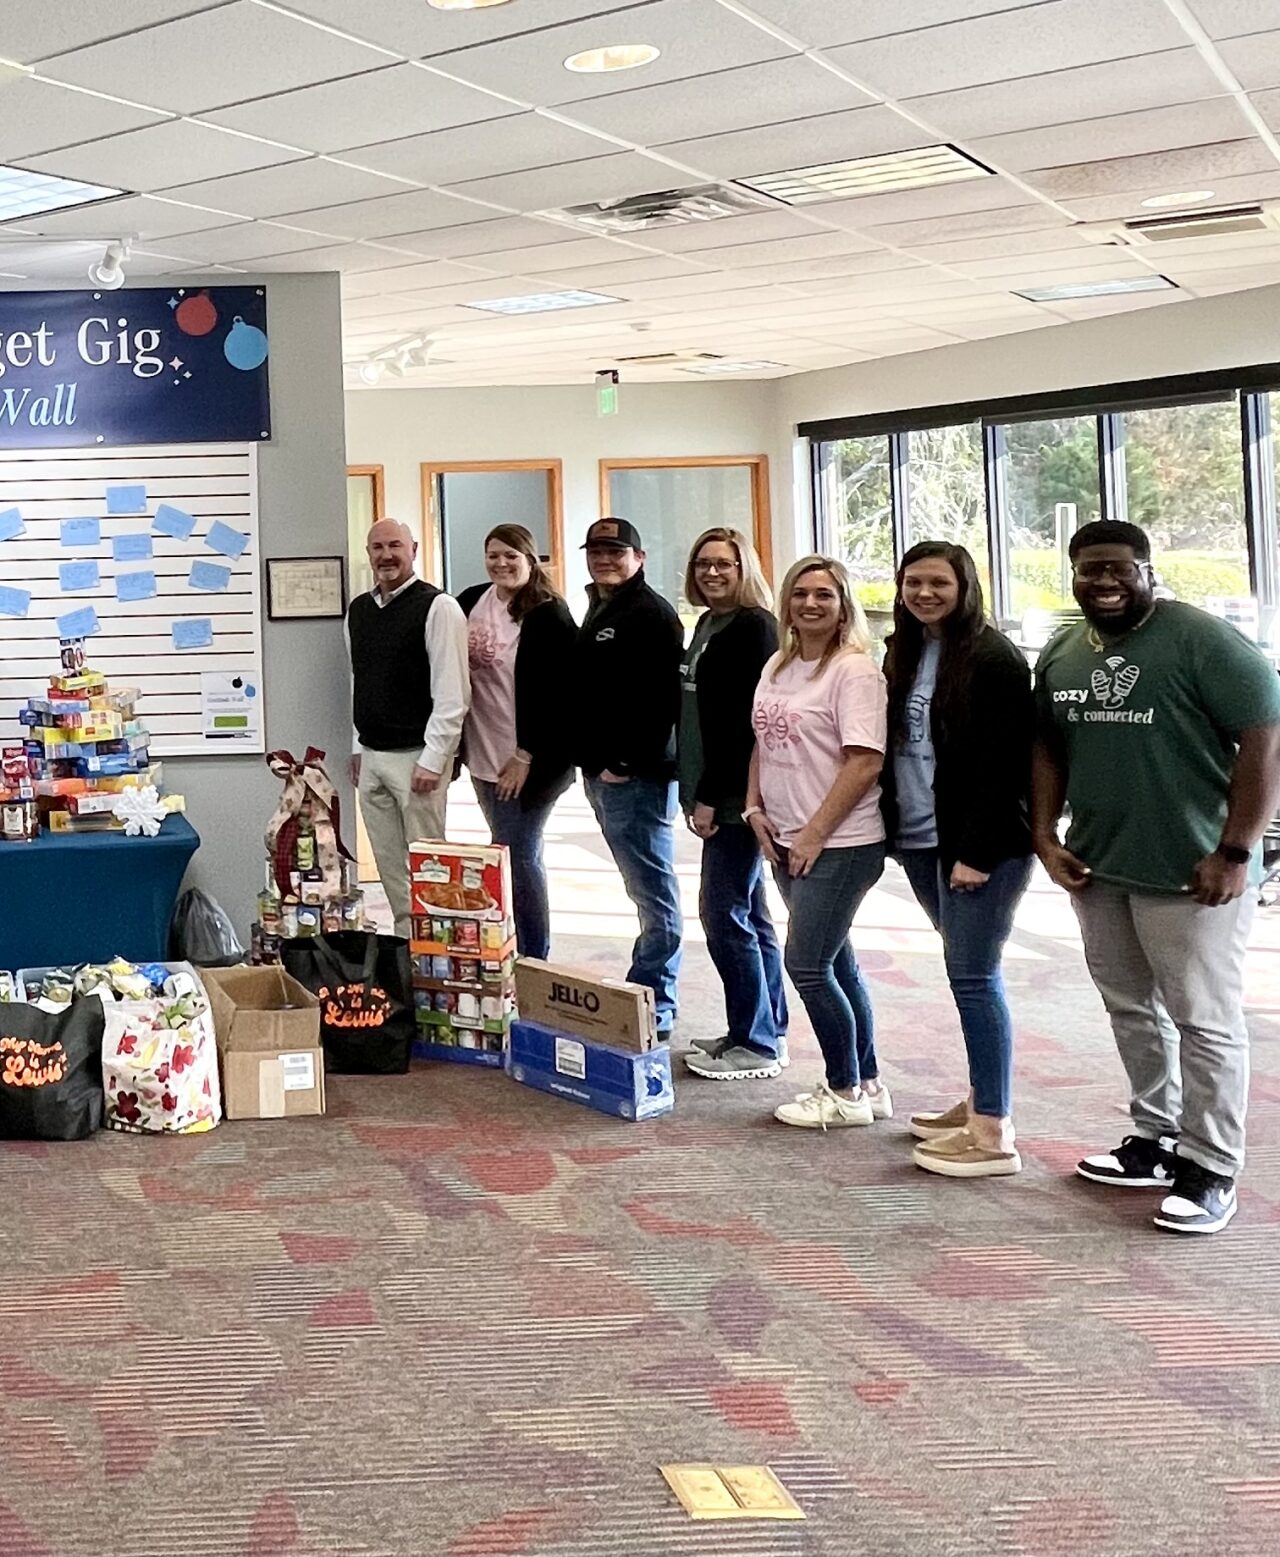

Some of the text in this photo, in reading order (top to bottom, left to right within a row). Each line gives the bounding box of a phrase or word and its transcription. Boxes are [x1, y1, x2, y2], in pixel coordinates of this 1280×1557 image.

[77, 317, 165, 378] Gig
[1053, 689, 1088, 703] cozy
[1067, 707, 1154, 724] & connected
